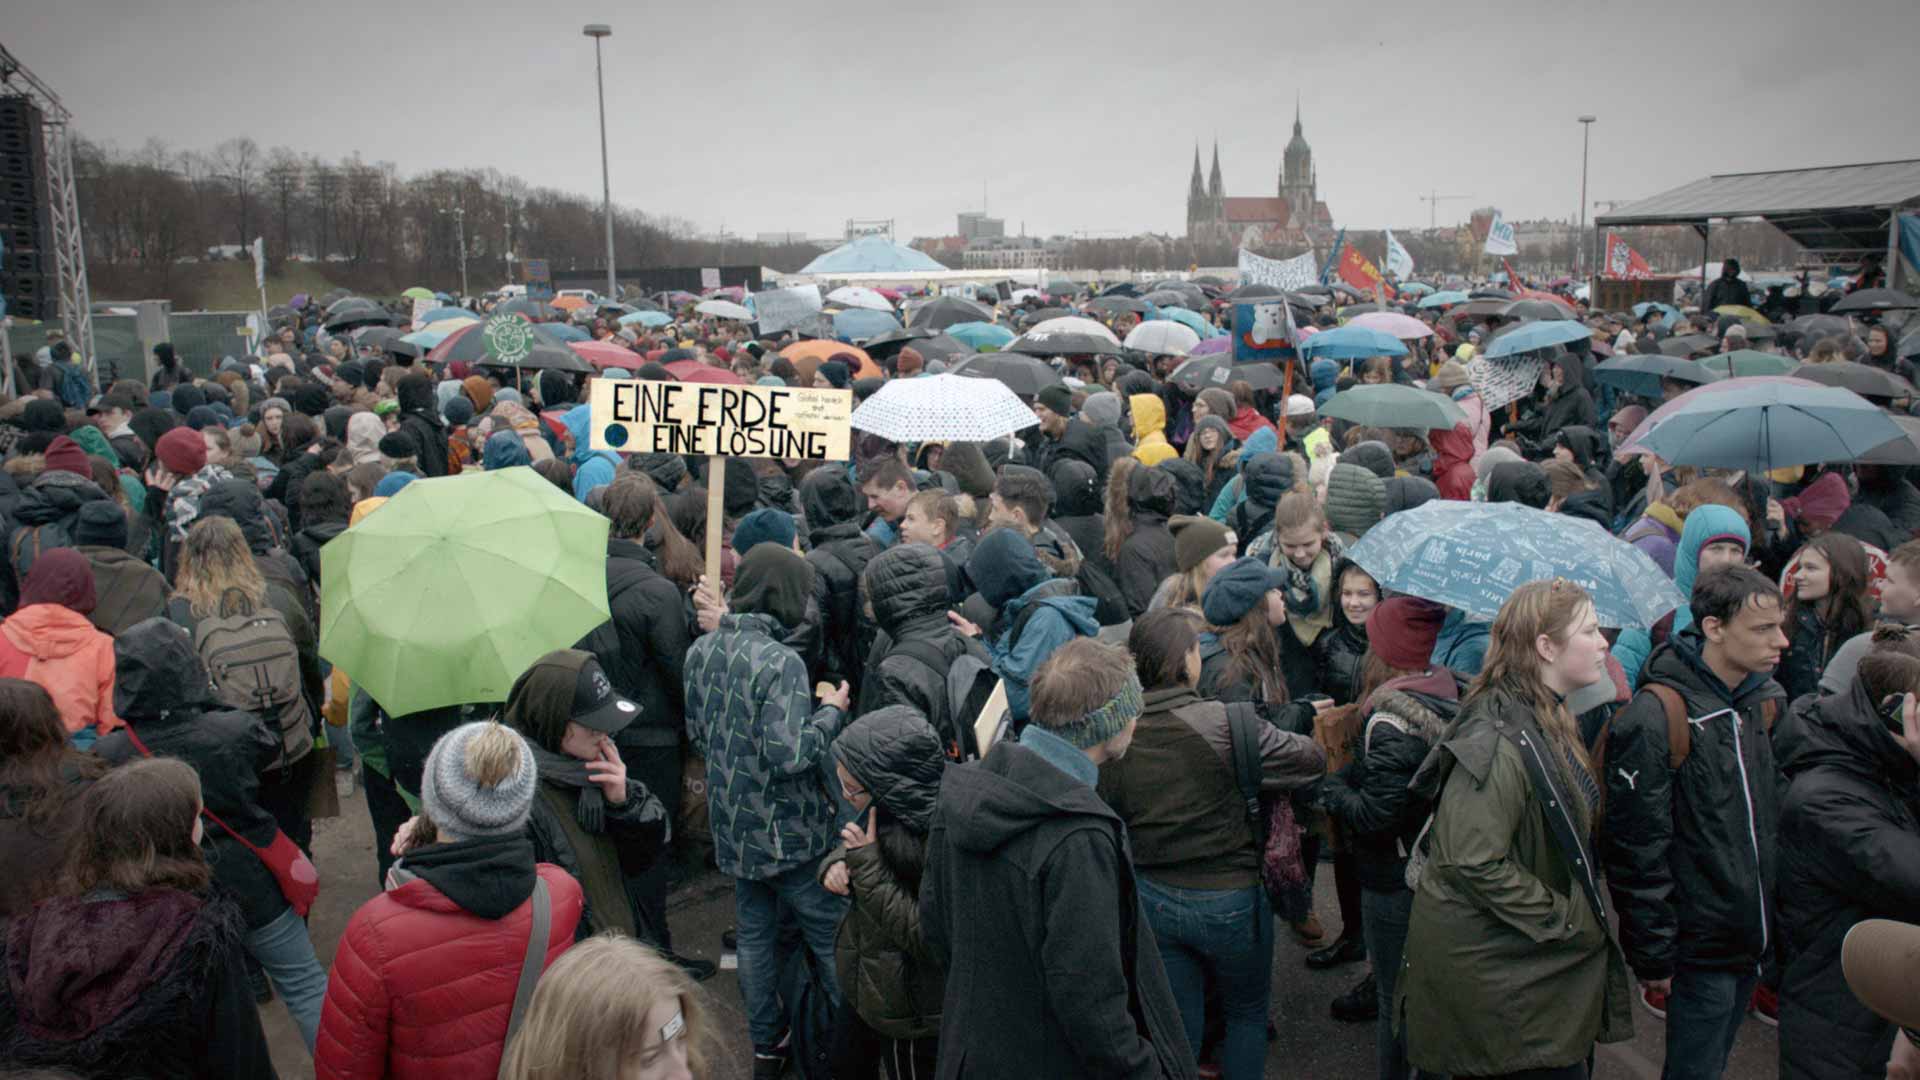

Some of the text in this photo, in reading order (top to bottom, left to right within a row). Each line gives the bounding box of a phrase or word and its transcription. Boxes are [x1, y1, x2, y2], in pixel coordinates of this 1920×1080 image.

[614, 384, 790, 430] EINE ERDE
[652, 425, 827, 459] EINE LÖSUNG
